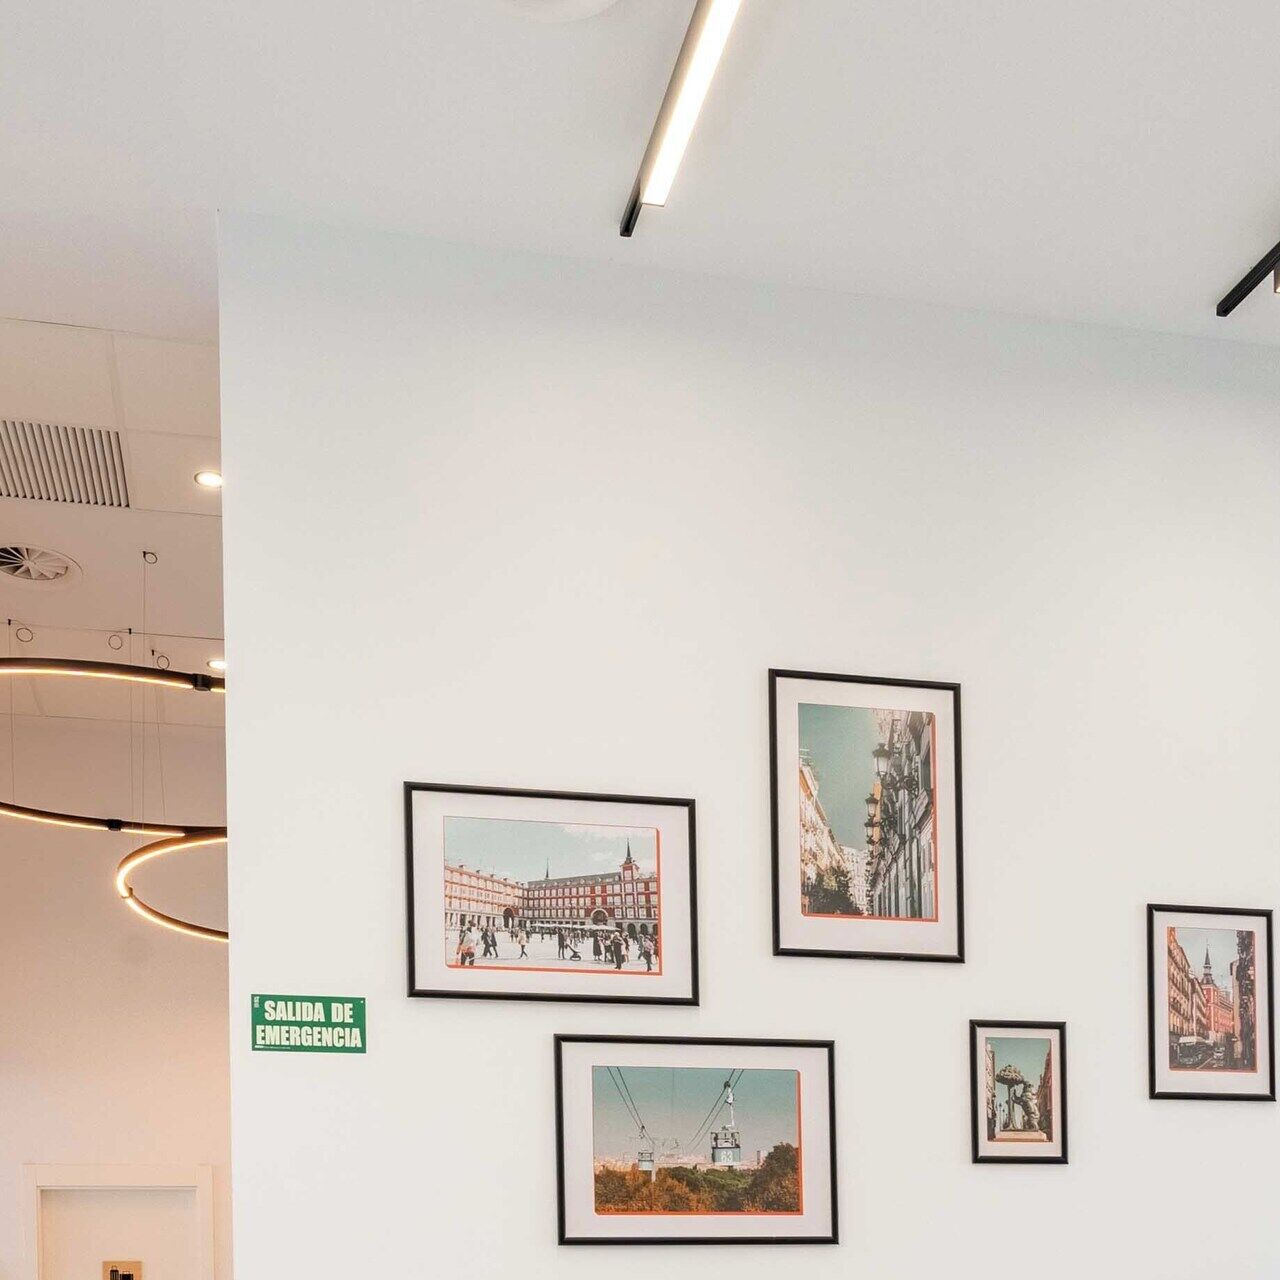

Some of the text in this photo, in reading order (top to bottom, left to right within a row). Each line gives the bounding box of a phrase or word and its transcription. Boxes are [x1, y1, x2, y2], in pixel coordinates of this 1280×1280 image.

[264, 1000, 326, 1022] SALIDA
[331, 1002, 354, 1023] DE
[255, 1024, 363, 1048] EMERGENCIA
